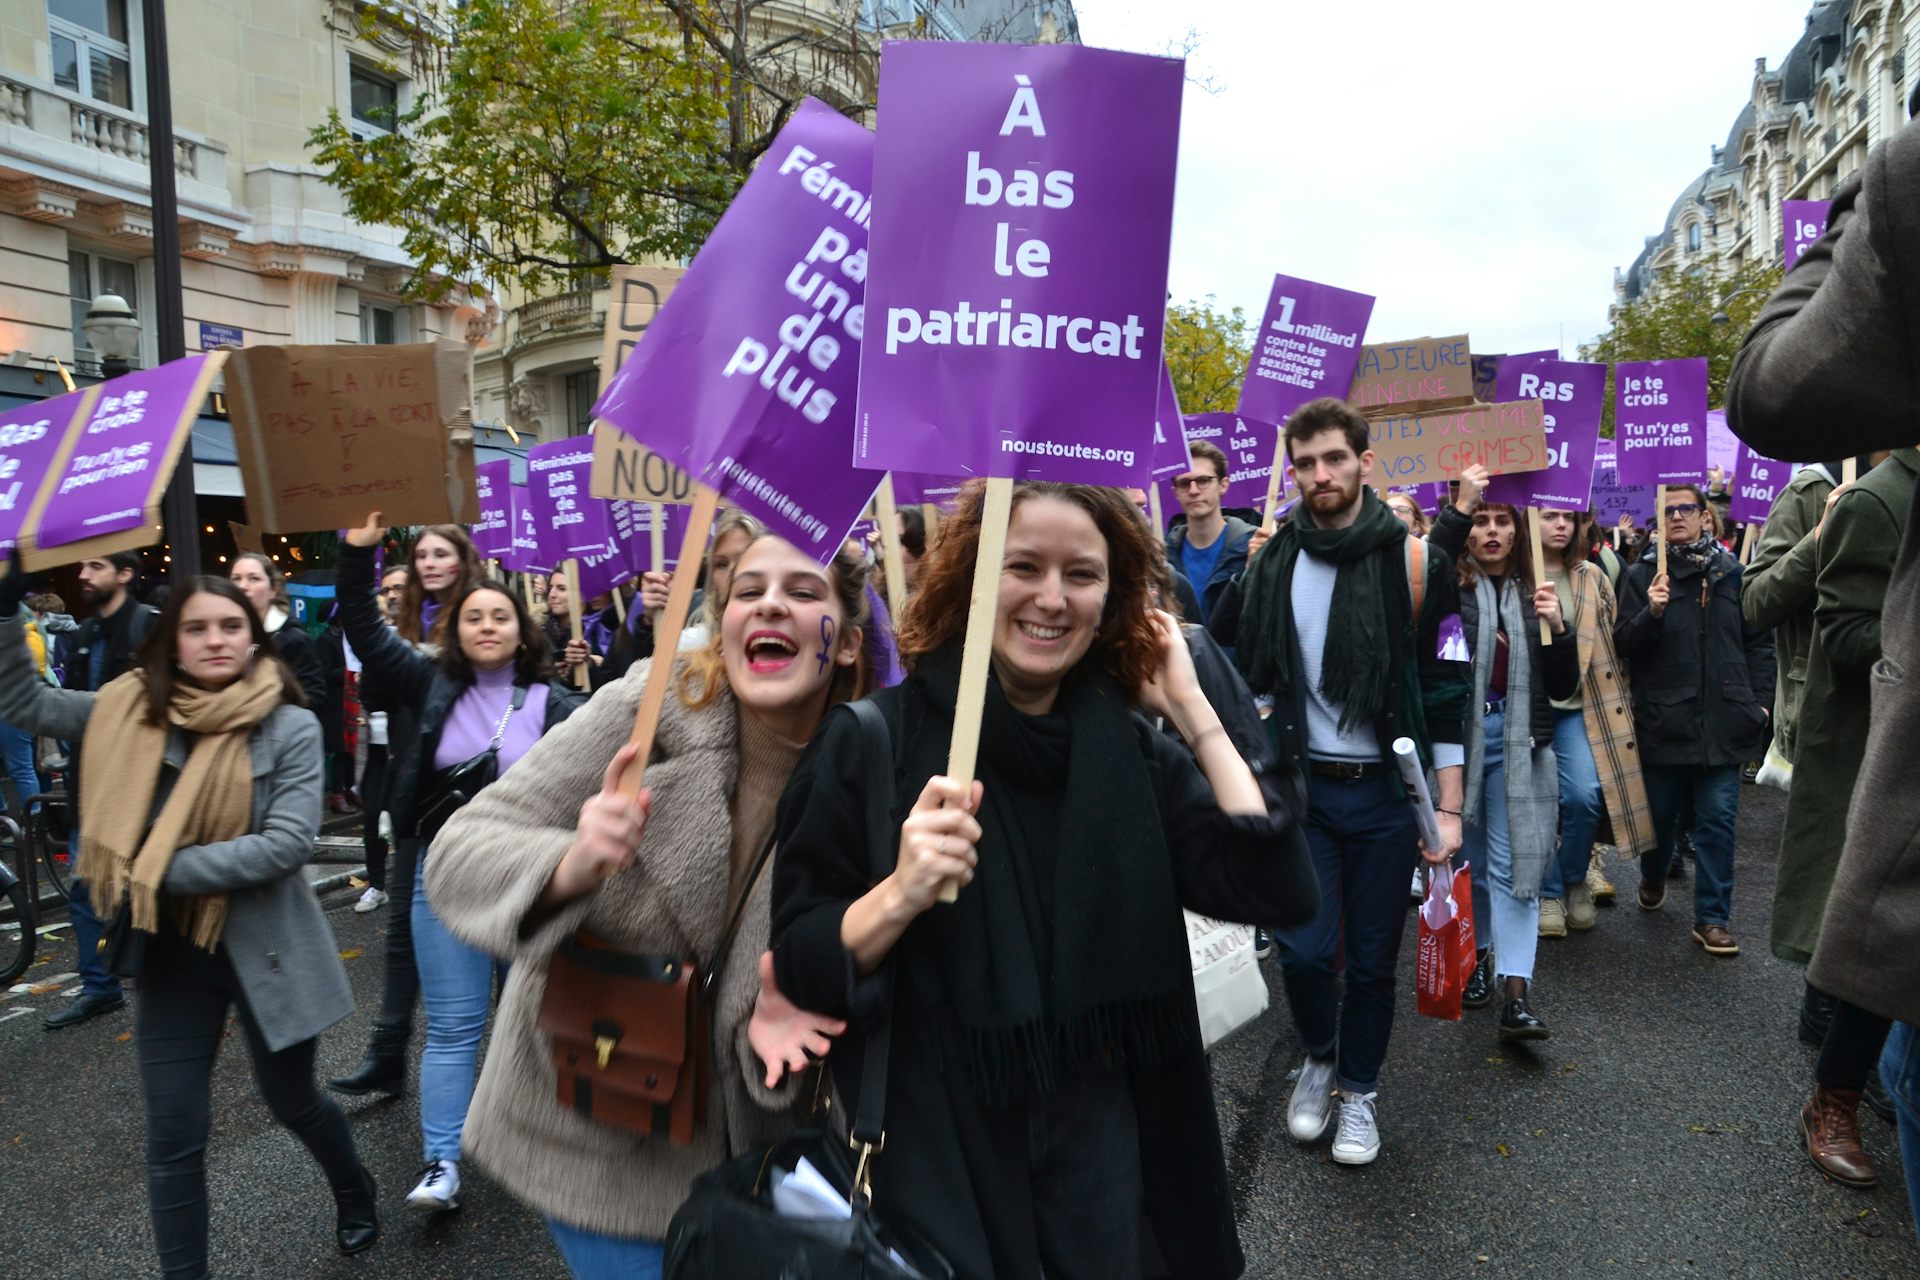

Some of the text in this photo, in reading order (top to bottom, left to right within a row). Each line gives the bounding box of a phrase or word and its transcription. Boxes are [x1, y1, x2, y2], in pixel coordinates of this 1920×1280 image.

[999, 75, 1046, 138] À
[778, 144, 872, 232] Fémi
[964, 151, 1075, 209] bas
[1794, 219, 1818, 241] Je
[803, 226, 869, 285] pa
[994, 222, 1051, 279] le
[784, 261, 865, 341] une
[885, 298, 1145, 359] patriarcat
[1271, 295, 1357, 349] 1 milliard
[778, 311, 841, 372] de
[1266, 335, 1328, 357] contre les
[1263, 345, 1322, 367] violences
[1256, 367, 1316, 389] sexuelles
[1259, 356, 1326, 380] sexistes et
[721, 336, 838, 425] plus
[1519, 373, 1575, 401] Ras
[1624, 376, 1663, 394] Je te
[215, 393, 226, 414] L
[1624, 390, 1669, 407] crois
[1184, 425, 1223, 440] nicides
[1235, 418, 1247, 433] À
[1368, 417, 1424, 442] UTES
[1544, 413, 1557, 434] e
[1624, 423, 1644, 436] Tu
[1671, 422, 1689, 433] es
[1001, 438, 1136, 467] noustoutes.org
[1229, 435, 1258, 451] bas
[1624, 434, 1693, 451] pour rien
[1240, 451, 1256, 464] le
[1546, 441, 1570, 468] ol
[612, 447, 692, 500] NOU
[1229, 465, 1274, 483] atriarca
[1381, 453, 1427, 480] VOS
[1750, 463, 1769, 480] le
[548, 470, 576, 487] pas
[548, 484, 578, 498] une
[1741, 483, 1775, 502] viol
[555, 496, 577, 511] de
[552, 511, 585, 529] plus
[294, 599, 306, 618] P
